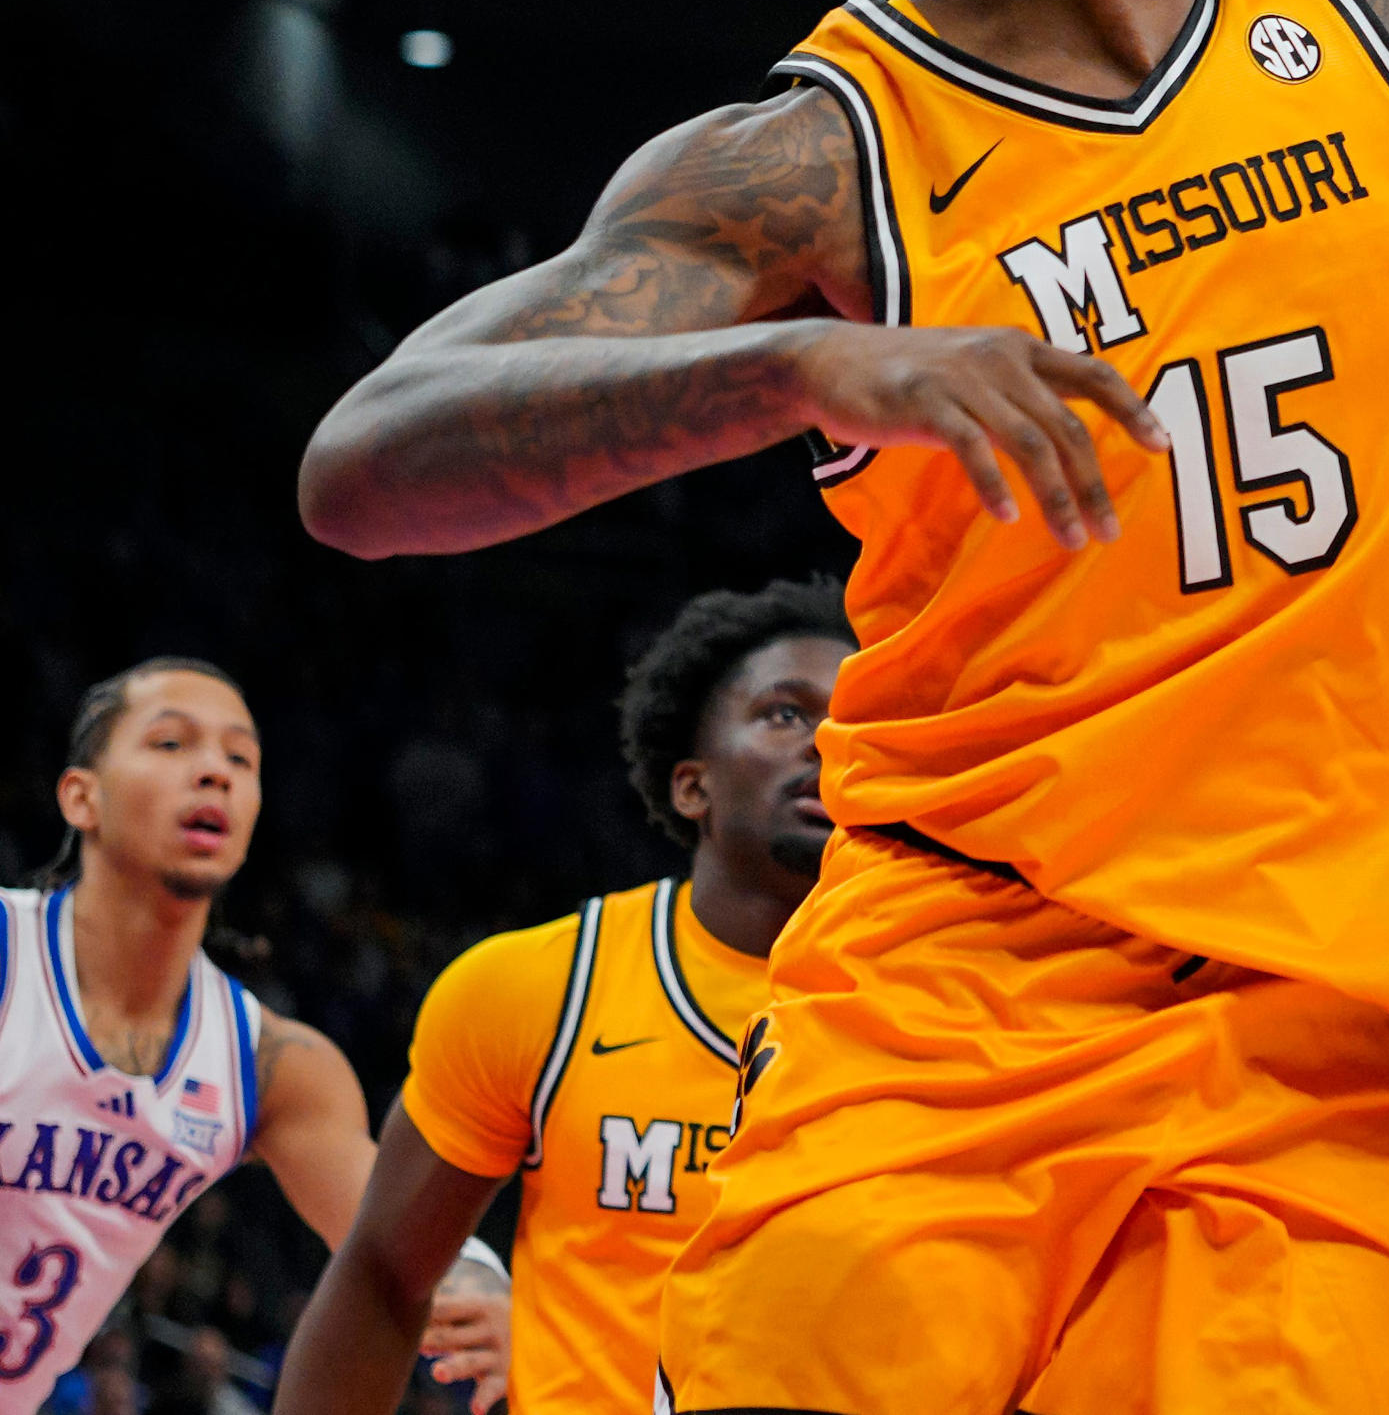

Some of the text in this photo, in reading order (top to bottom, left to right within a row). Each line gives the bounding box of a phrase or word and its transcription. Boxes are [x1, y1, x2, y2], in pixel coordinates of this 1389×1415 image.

[1249, 16, 1320, 79] SEC
[997, 131, 1370, 355] MISSOURI
[1143, 325, 1358, 595] 15
[0, 1121, 205, 1223] ANSA
